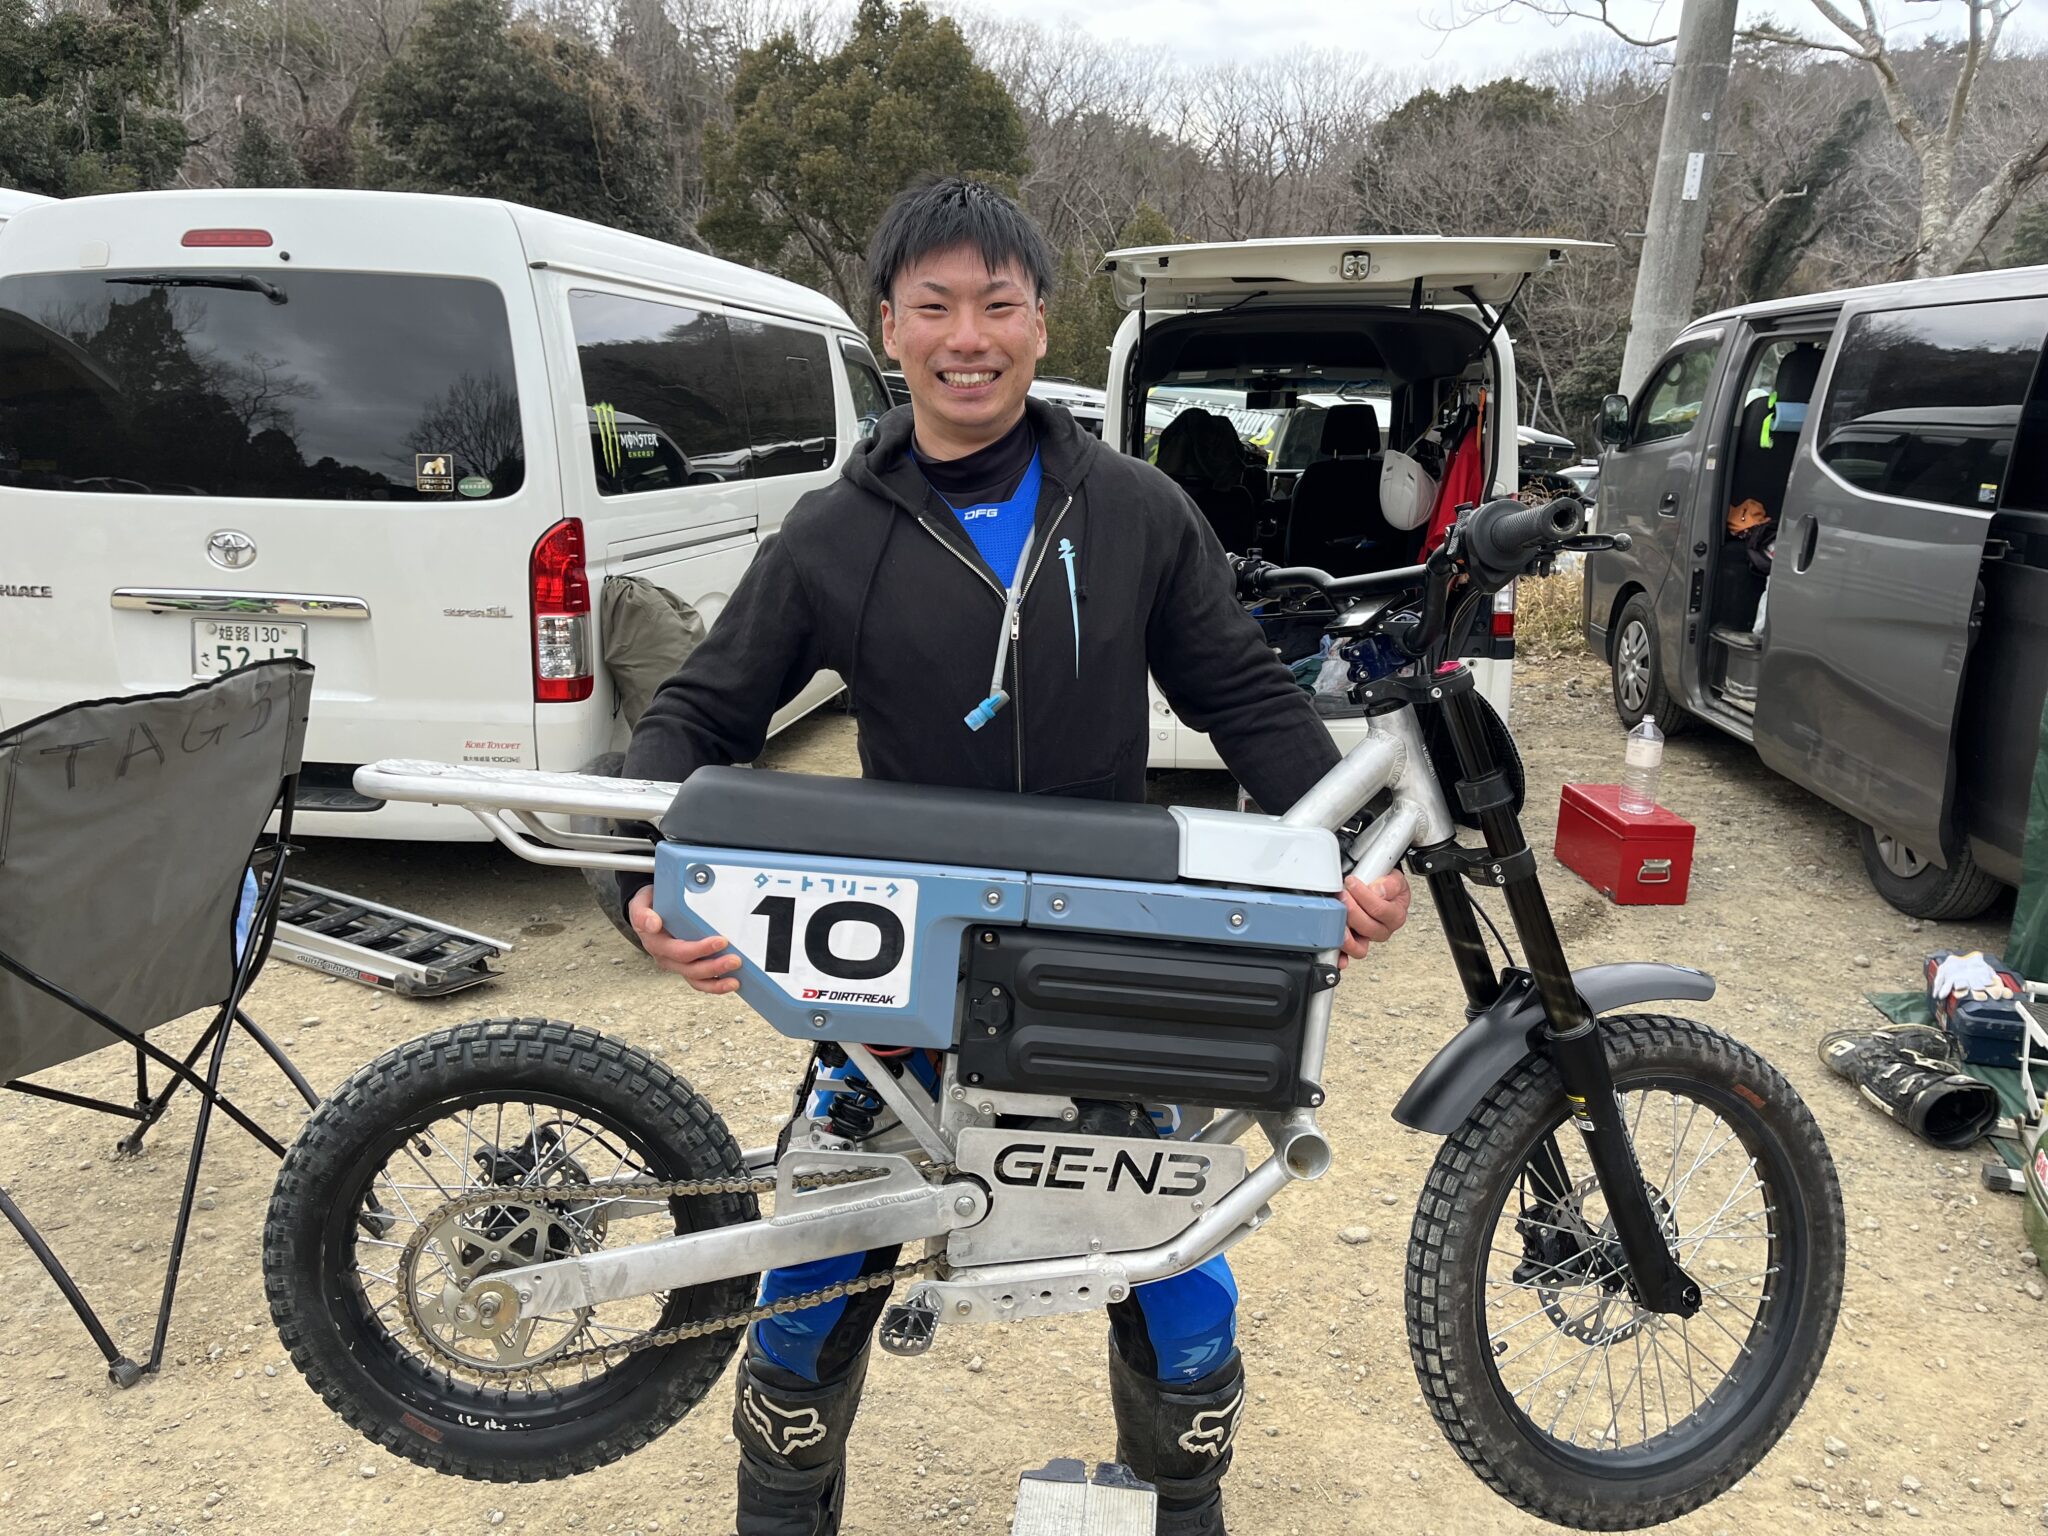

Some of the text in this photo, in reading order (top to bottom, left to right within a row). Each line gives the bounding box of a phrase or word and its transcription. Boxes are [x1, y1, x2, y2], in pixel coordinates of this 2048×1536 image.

[620, 431, 659, 449] MONSTER
[627, 450, 655, 458] ENERGY
[964, 508, 999, 521] DFG
[753, 872, 900, 899] ダートフリーク
[750, 895, 906, 980] 10
[828, 991, 897, 1005] DIRTFREAK
[993, 1143, 1211, 1197] GE-N3
